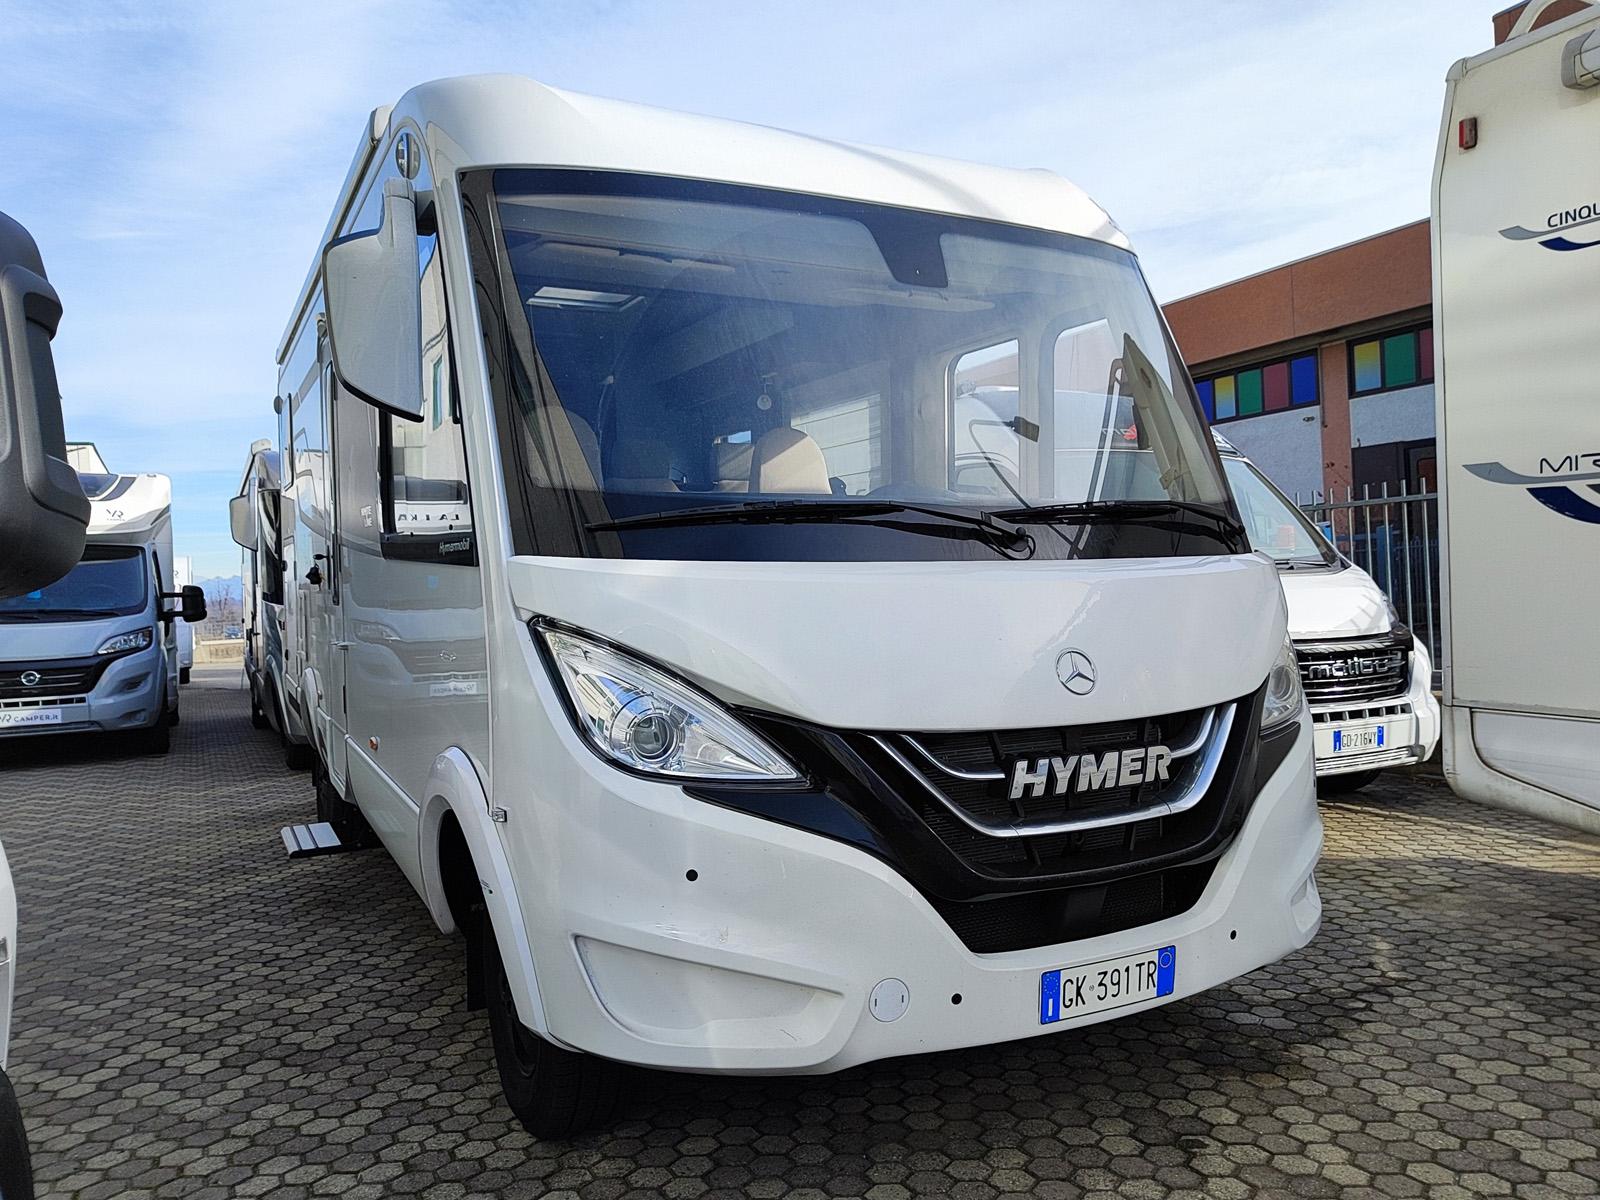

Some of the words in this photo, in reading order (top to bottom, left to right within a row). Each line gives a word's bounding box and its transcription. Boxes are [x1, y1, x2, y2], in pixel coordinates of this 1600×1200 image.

[1010, 745, 1172, 799] HYMER
[1062, 975, 1087, 1008] GK
[1097, 960, 1157, 1001] 391TR
